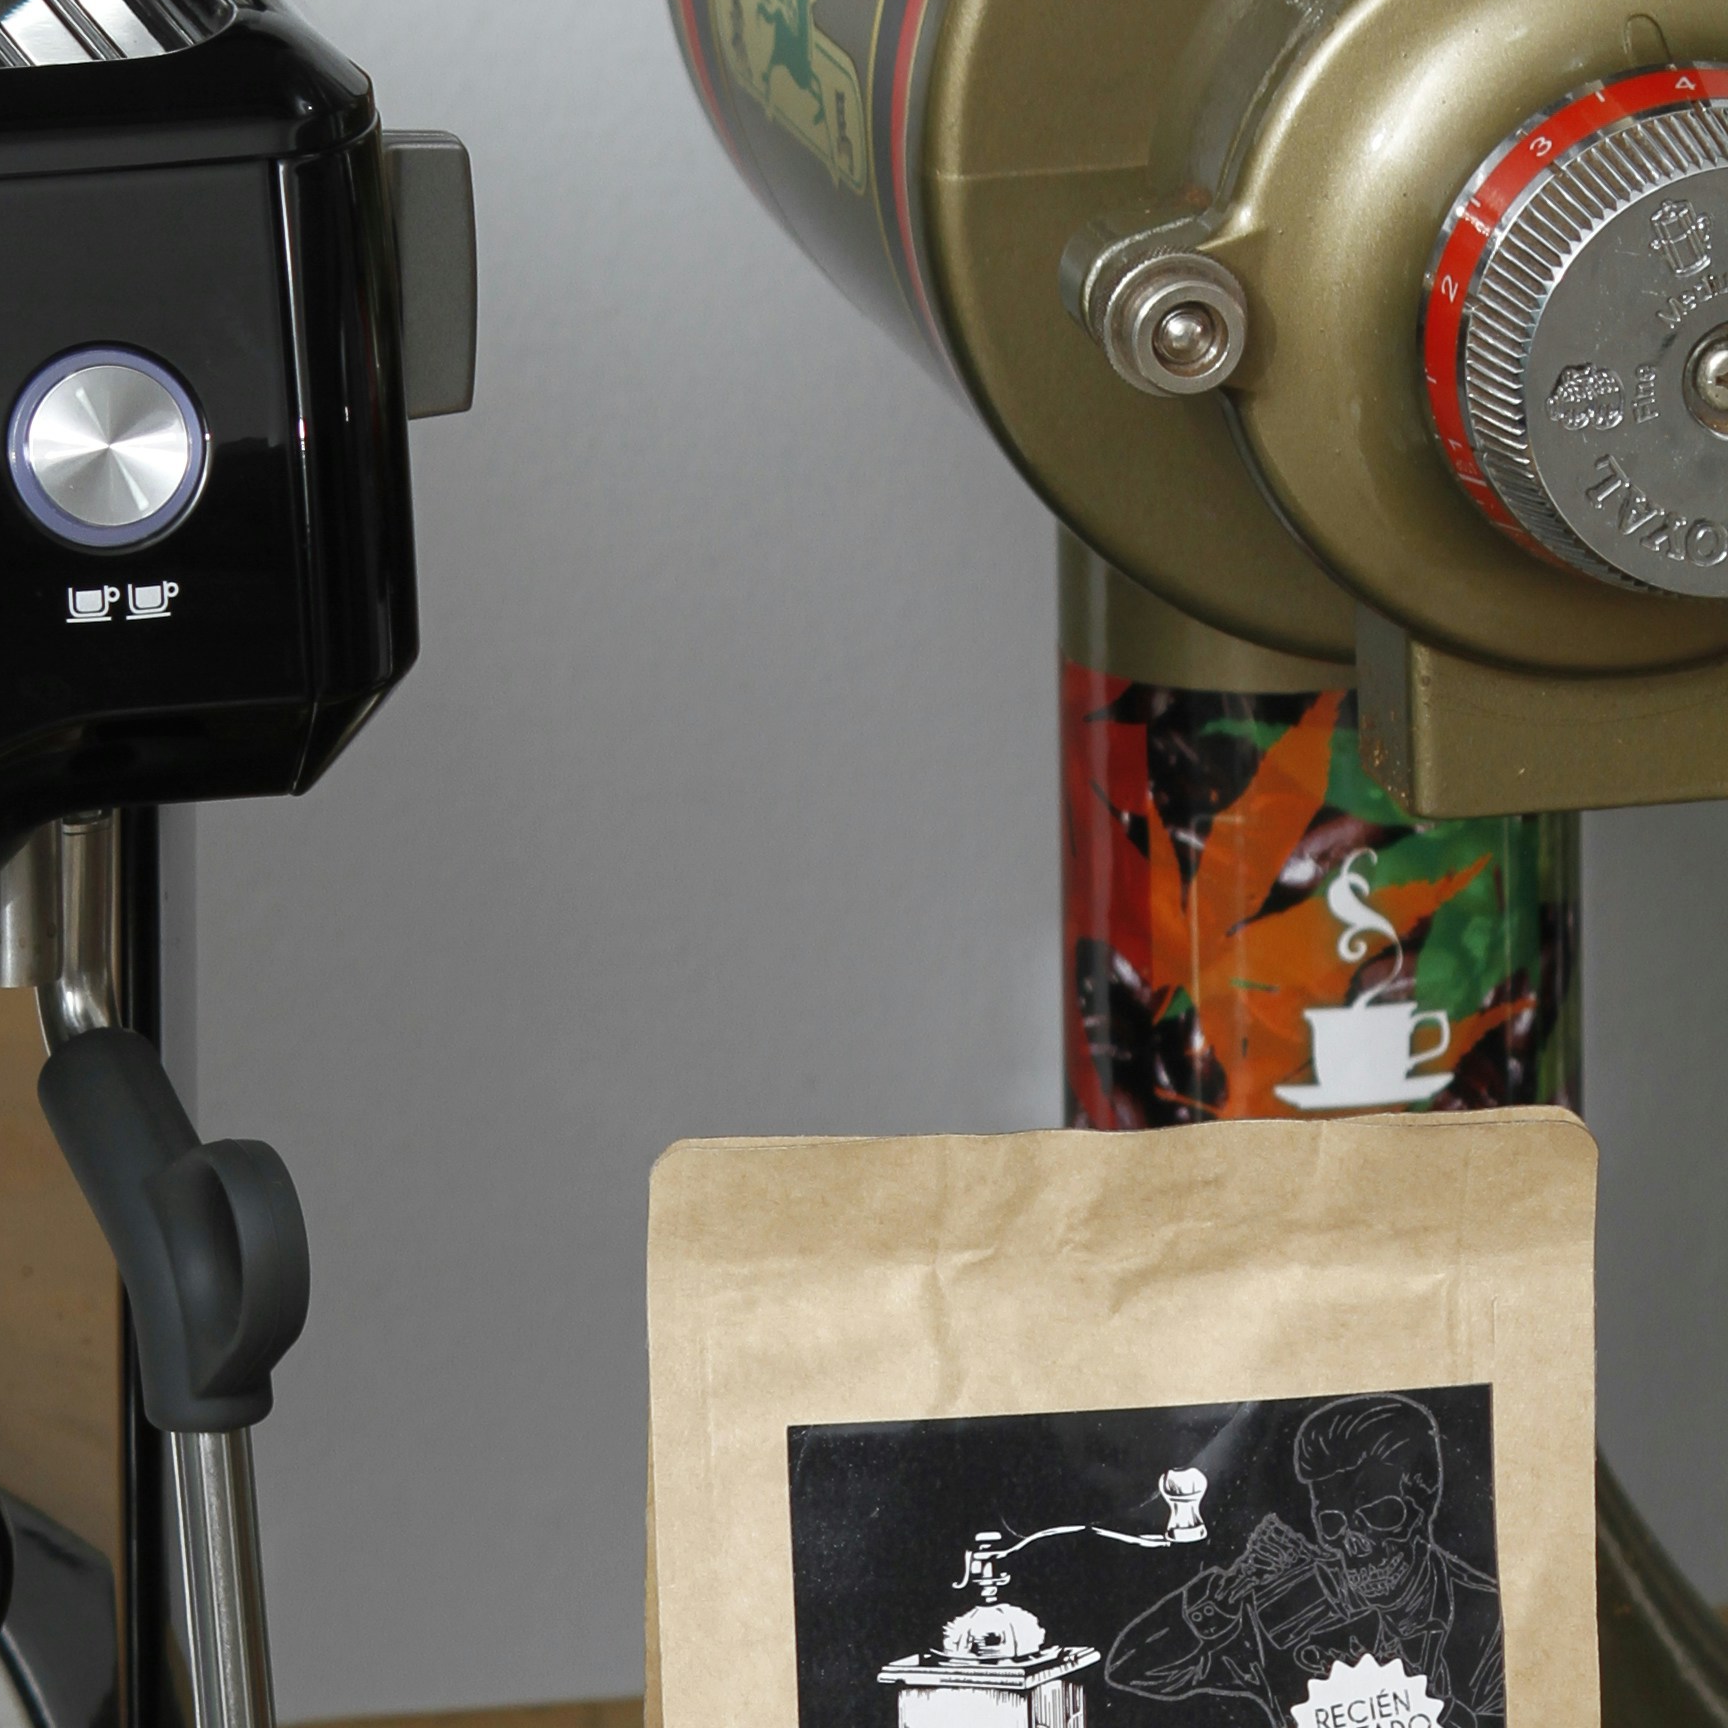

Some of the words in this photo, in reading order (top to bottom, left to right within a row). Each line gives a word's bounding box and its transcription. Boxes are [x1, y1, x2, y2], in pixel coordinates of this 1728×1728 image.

[1675, 76, 1696, 92] 4
[1529, 136, 1553, 157] 3
[1441, 274, 1459, 303] 2
[1633, 364, 1660, 423] Fine
